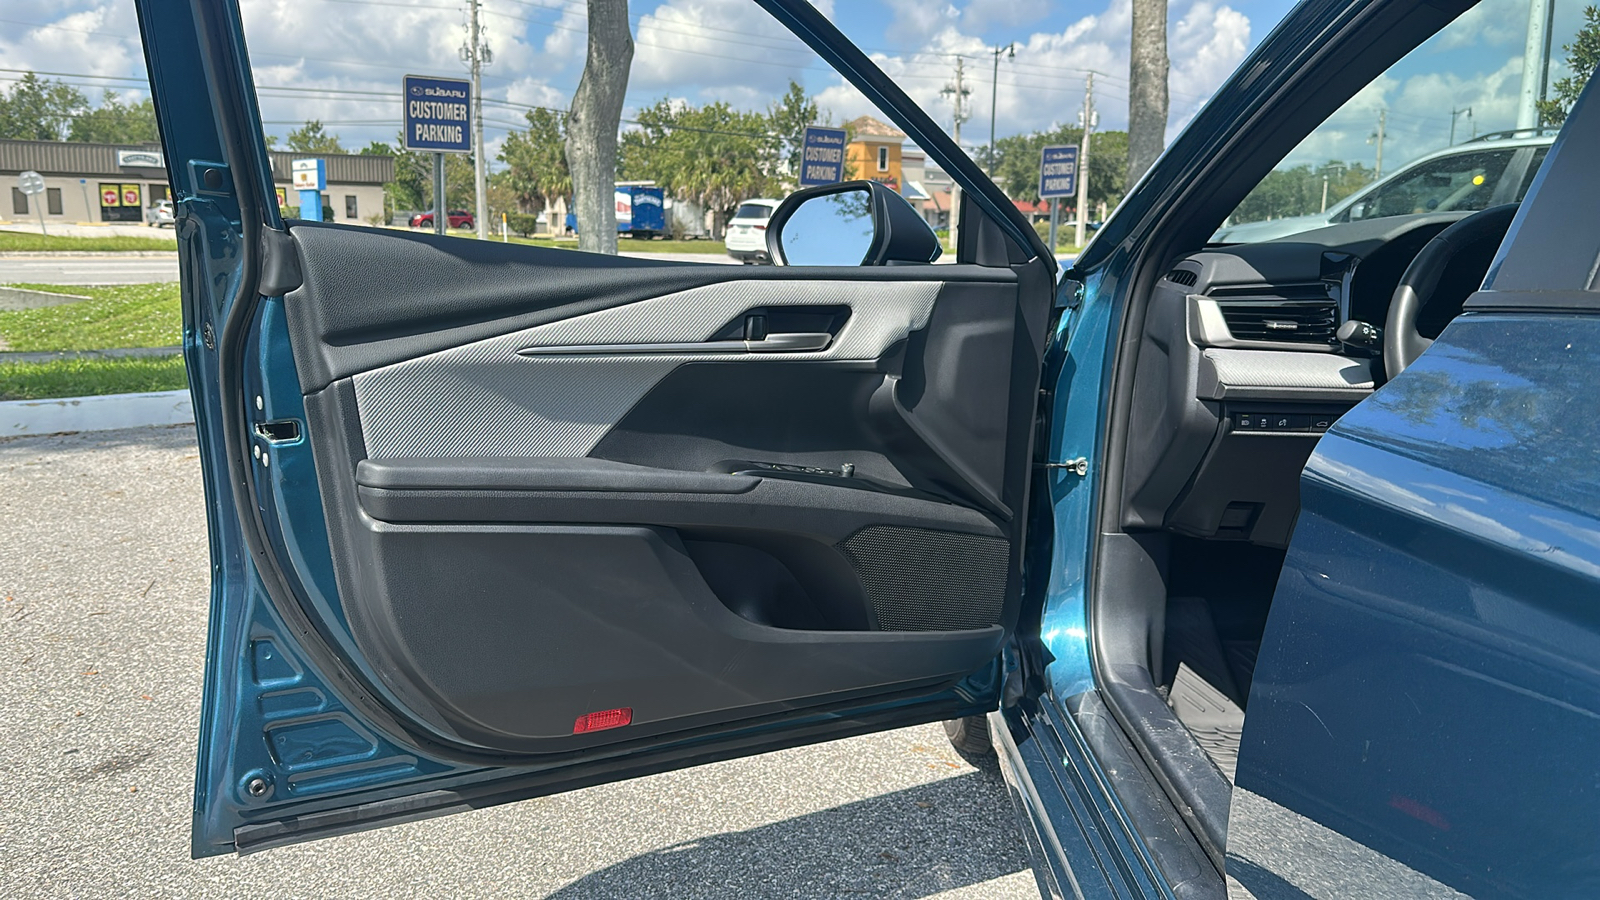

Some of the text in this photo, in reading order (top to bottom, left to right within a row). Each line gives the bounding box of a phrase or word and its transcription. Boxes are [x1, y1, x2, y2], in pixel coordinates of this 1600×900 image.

[425, 87, 466, 98] SUBARU
[409, 100, 467, 121] CUSTOMER
[415, 123, 462, 143] PARKING
[805, 146, 842, 163] CUSTOMER
[806, 165, 837, 181] PARKING
